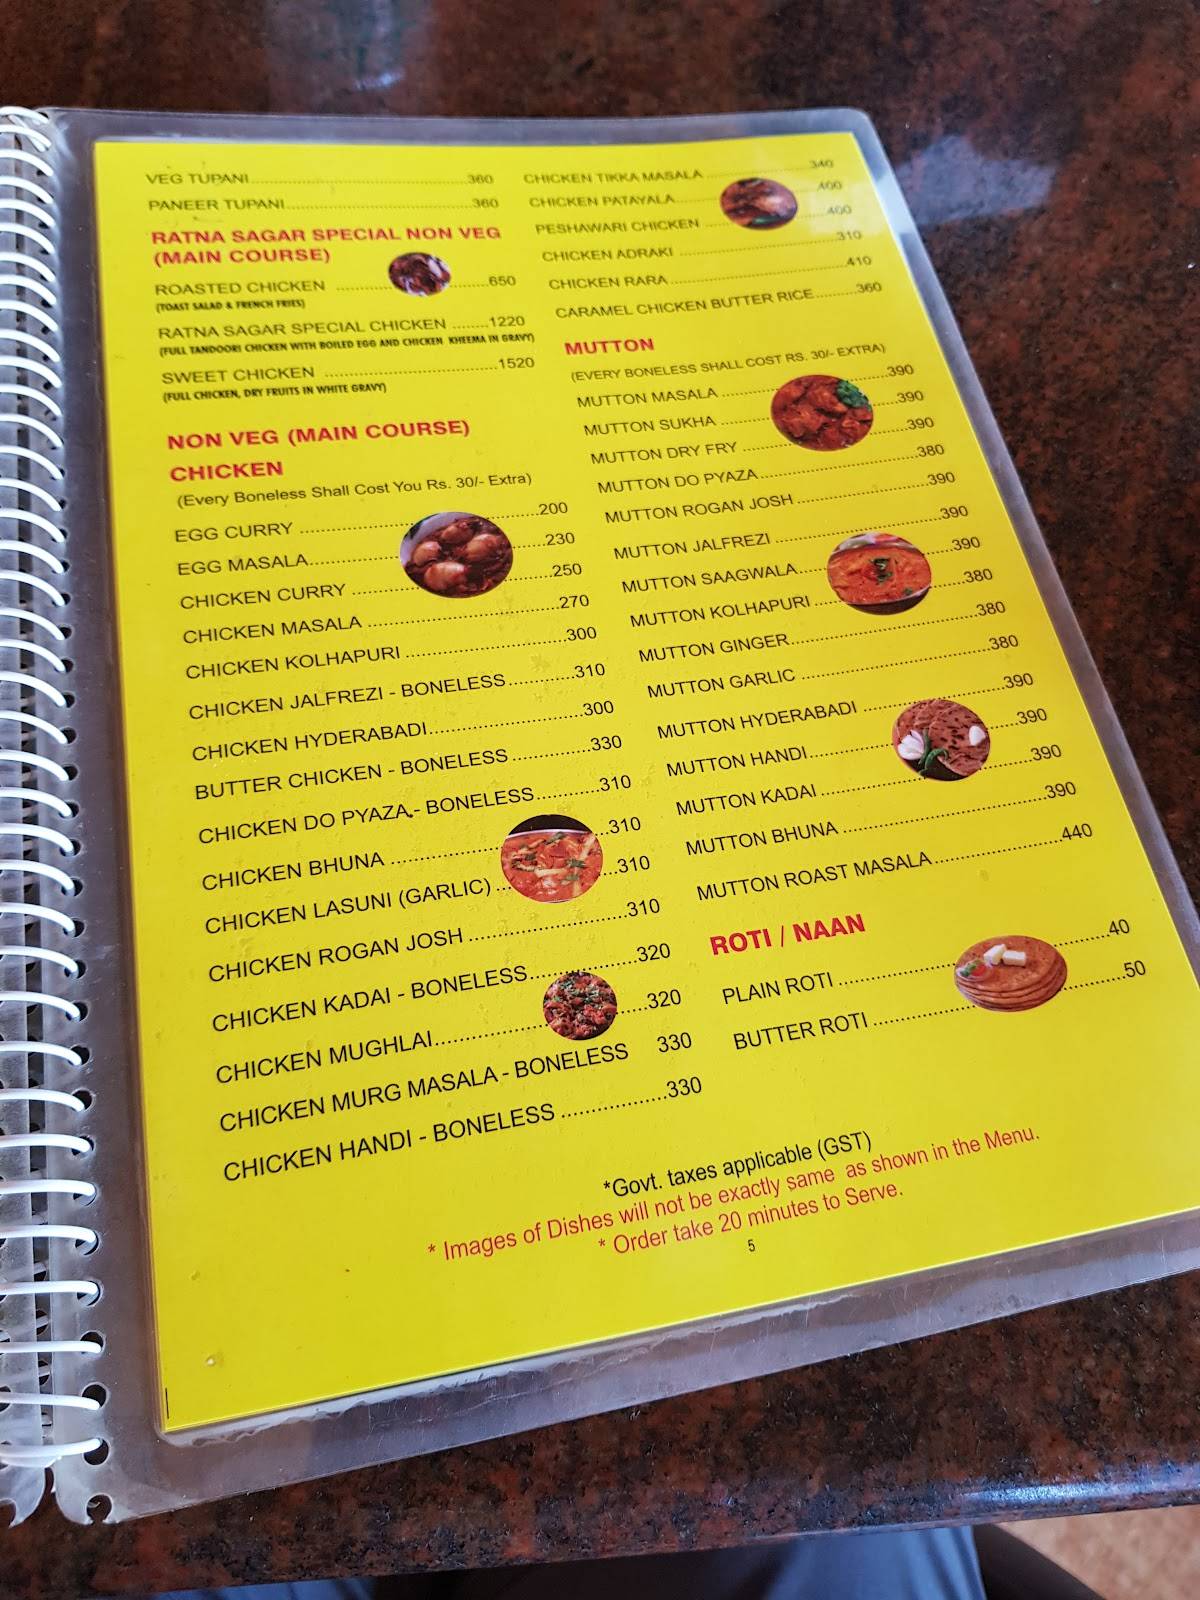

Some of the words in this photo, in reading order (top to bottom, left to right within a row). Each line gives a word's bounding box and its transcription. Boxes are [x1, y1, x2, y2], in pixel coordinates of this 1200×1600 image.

[145, 172, 184, 185] VEG
[187, 172, 250, 185] TUPANI
[466, 173, 495, 185] 360
[150, 229, 226, 245] RATNA
[230, 228, 307, 244] SAGAR
[311, 227, 402, 242] SPECIAL
[405, 226, 453, 241] NON
[457, 226, 502, 240] VEG
[153, 249, 222, 269] (MAIN
[228, 247, 331, 264] COURSE)
[541, 248, 613, 263] CHICKEN
[616, 246, 674, 260] ADRAKI
[835, 229, 863, 242] 310
[154, 282, 243, 296] ROASTED
[245, 279, 326, 294] CHICKEN
[488, 275, 517, 287] 650
[155, 301, 190, 314] (TOAST
[191, 300, 224, 311] SALAD
[235, 299, 274, 310] FRENCH
[275, 298, 306, 310] FRIES)
[555, 304, 634, 319] CARAMEL
[635, 299, 708, 315] CHICKEN
[709, 292, 775, 310] BUTTER
[776, 287, 815, 303] RICE
[855, 281, 883, 295] 360
[157, 325, 220, 340] RATNA
[222, 323, 287, 338] SAGAR
[290, 321, 366, 335] SPECIAL
[369, 317, 447, 332] CHICKEN
[488, 314, 526, 328] 1220
[563, 337, 655, 356] MUTTON
[161, 369, 228, 385] SWEET
[232, 366, 315, 382] CHICKEN
[497, 356, 536, 370] 1520
[570, 368, 622, 384] (EVERY
[623, 363, 698, 379] BONELESS
[699, 359, 744, 373] SHALL
[745, 354, 782, 368] COST
[784, 351, 808, 363] RS.
[810, 348, 835, 360] 30/-
[836, 343, 887, 358] EXTRA)
[162, 391, 192, 404] (FULL
[192, 388, 242, 401] CHICKEN,
[242, 387, 264, 398] DRY
[265, 386, 301, 397] FRUITS
[301, 385, 315, 395] IN
[315, 383, 349, 395] WHITE
[350, 382, 387, 394] GRAVY)
[167, 432, 223, 450] NON
[228, 429, 280, 447] VEG
[287, 425, 359, 448] (MAIN
[364, 419, 470, 440] COURSE)
[589, 448, 663, 465] MUTTON
[666, 444, 701, 459] DRY
[704, 441, 737, 456] FRY
[906, 416, 935, 431] 390
[169, 460, 284, 483] CHICKEN
[176, 493, 230, 510] (Every
[233, 488, 307, 504] Boneless
[311, 484, 350, 499] Shall
[353, 482, 391, 496] Cost
[392, 480, 423, 493] You
[426, 478, 452, 491] Rs.
[455, 475, 485, 489] 30/-
[487, 472, 532, 487] Extra)
[604, 505, 679, 524] MUTTON
[681, 499, 745, 518] ROGAN
[748, 493, 794, 510] JOSH
[927, 471, 957, 487] 390
[174, 527, 219, 543] EGG
[224, 521, 293, 540] CURRY
[538, 501, 569, 516] 200
[613, 541, 688, 560] MUTTON
[692, 532, 771, 553] JALFREZI
[939, 505, 969, 521] 390
[179, 589, 272, 610] CHICKEN
[276, 583, 346, 602] CURRY
[551, 562, 583, 578] 250
[629, 607, 706, 628] MUTTON
[709, 595, 811, 620] KOLHAPURI
[963, 568, 994, 585] 380
[185, 657, 279, 680] CHICKEN
[285, 645, 401, 670] KOLHAPURI
[566, 626, 597, 643] 300
[638, 641, 716, 663] MUTTON
[719, 633, 793, 654] GINGER
[975, 600, 1007, 618] 380
[188, 696, 284, 720] CHICKEN
[289, 686, 384, 710] JALFREZI
[400, 673, 506, 698] BONELESS
[574, 662, 606, 679] 310
[195, 775, 283, 800] BUTTER
[288, 763, 383, 789] CHICKEN
[400, 748, 509, 776] BONELESS
[590, 734, 623, 752] 330
[675, 791, 757, 816] MUTTON
[759, 783, 817, 805] KADAI
[1030, 743, 1063, 762] 390
[696, 874, 780, 901] MUTTON
[783, 863, 848, 888] ROAST
[852, 851, 933, 877] MASALA
[1061, 822, 1093, 843] 440
[205, 904, 307, 935] CHICKEN
[313, 891, 392, 919] LASUNI
[398, 877, 491, 910] (GARLIC)
[616, 855, 651, 875] 310
[709, 927, 773, 956] ROTI
[792, 913, 866, 943] NAAN
[722, 979, 781, 1005] PLAIN
[784, 971, 834, 995] ROTI
[1108, 918, 1131, 936] 40
[212, 999, 317, 1033] CHICKEN
[323, 986, 391, 1015] KADAI
[410, 965, 528, 1000] BONELESS
[636, 942, 671, 963] 320
[733, 1021, 817, 1051] BUTTER
[818, 1011, 868, 1036] ROTI
[1123, 959, 1147, 980] 50
[219, 1096, 326, 1132] CHICKEN
[331, 1083, 402, 1113] MURG
[407, 1065, 499, 1099] MASALA
[514, 1042, 629, 1079] BONELESS
[656, 1031, 692, 1053] 330
[223, 1144, 332, 1182] CHICKEN
[339, 1128, 412, 1161] HANDI
[432, 1102, 555, 1143] BONELESS
[666, 1076, 702, 1099] 330
[666, 1164, 718, 1187] taxes
[722, 1143, 813, 1179] applicable
[817, 1130, 872, 1162] (GST)
[443, 1232, 518, 1261] Images
[522, 1221, 542, 1245] of
[546, 1212, 614, 1240] Dishes
[618, 1200, 650, 1225] will
[654, 1194, 686, 1217] not
[687, 1191, 713, 1211] be
[718, 1175, 780, 1204] exactly
[785, 1168, 836, 1193] same
[845, 1162, 868, 1179] as
[871, 1149, 929, 1174] shown
[932, 1145, 950, 1161] in
[951, 1138, 982, 1157] the
[983, 1127, 1040, 1150] Menu.
[613, 1229, 668, 1255] Order
[672, 1219, 714, 1243] take
[718, 1210, 742, 1233] 20
[747, 1199, 819, 1228] minutes
[821, 1193, 841, 1212] to
[844, 1183, 903, 1206] Serve.
[747, 1238, 756, 1253] 5
